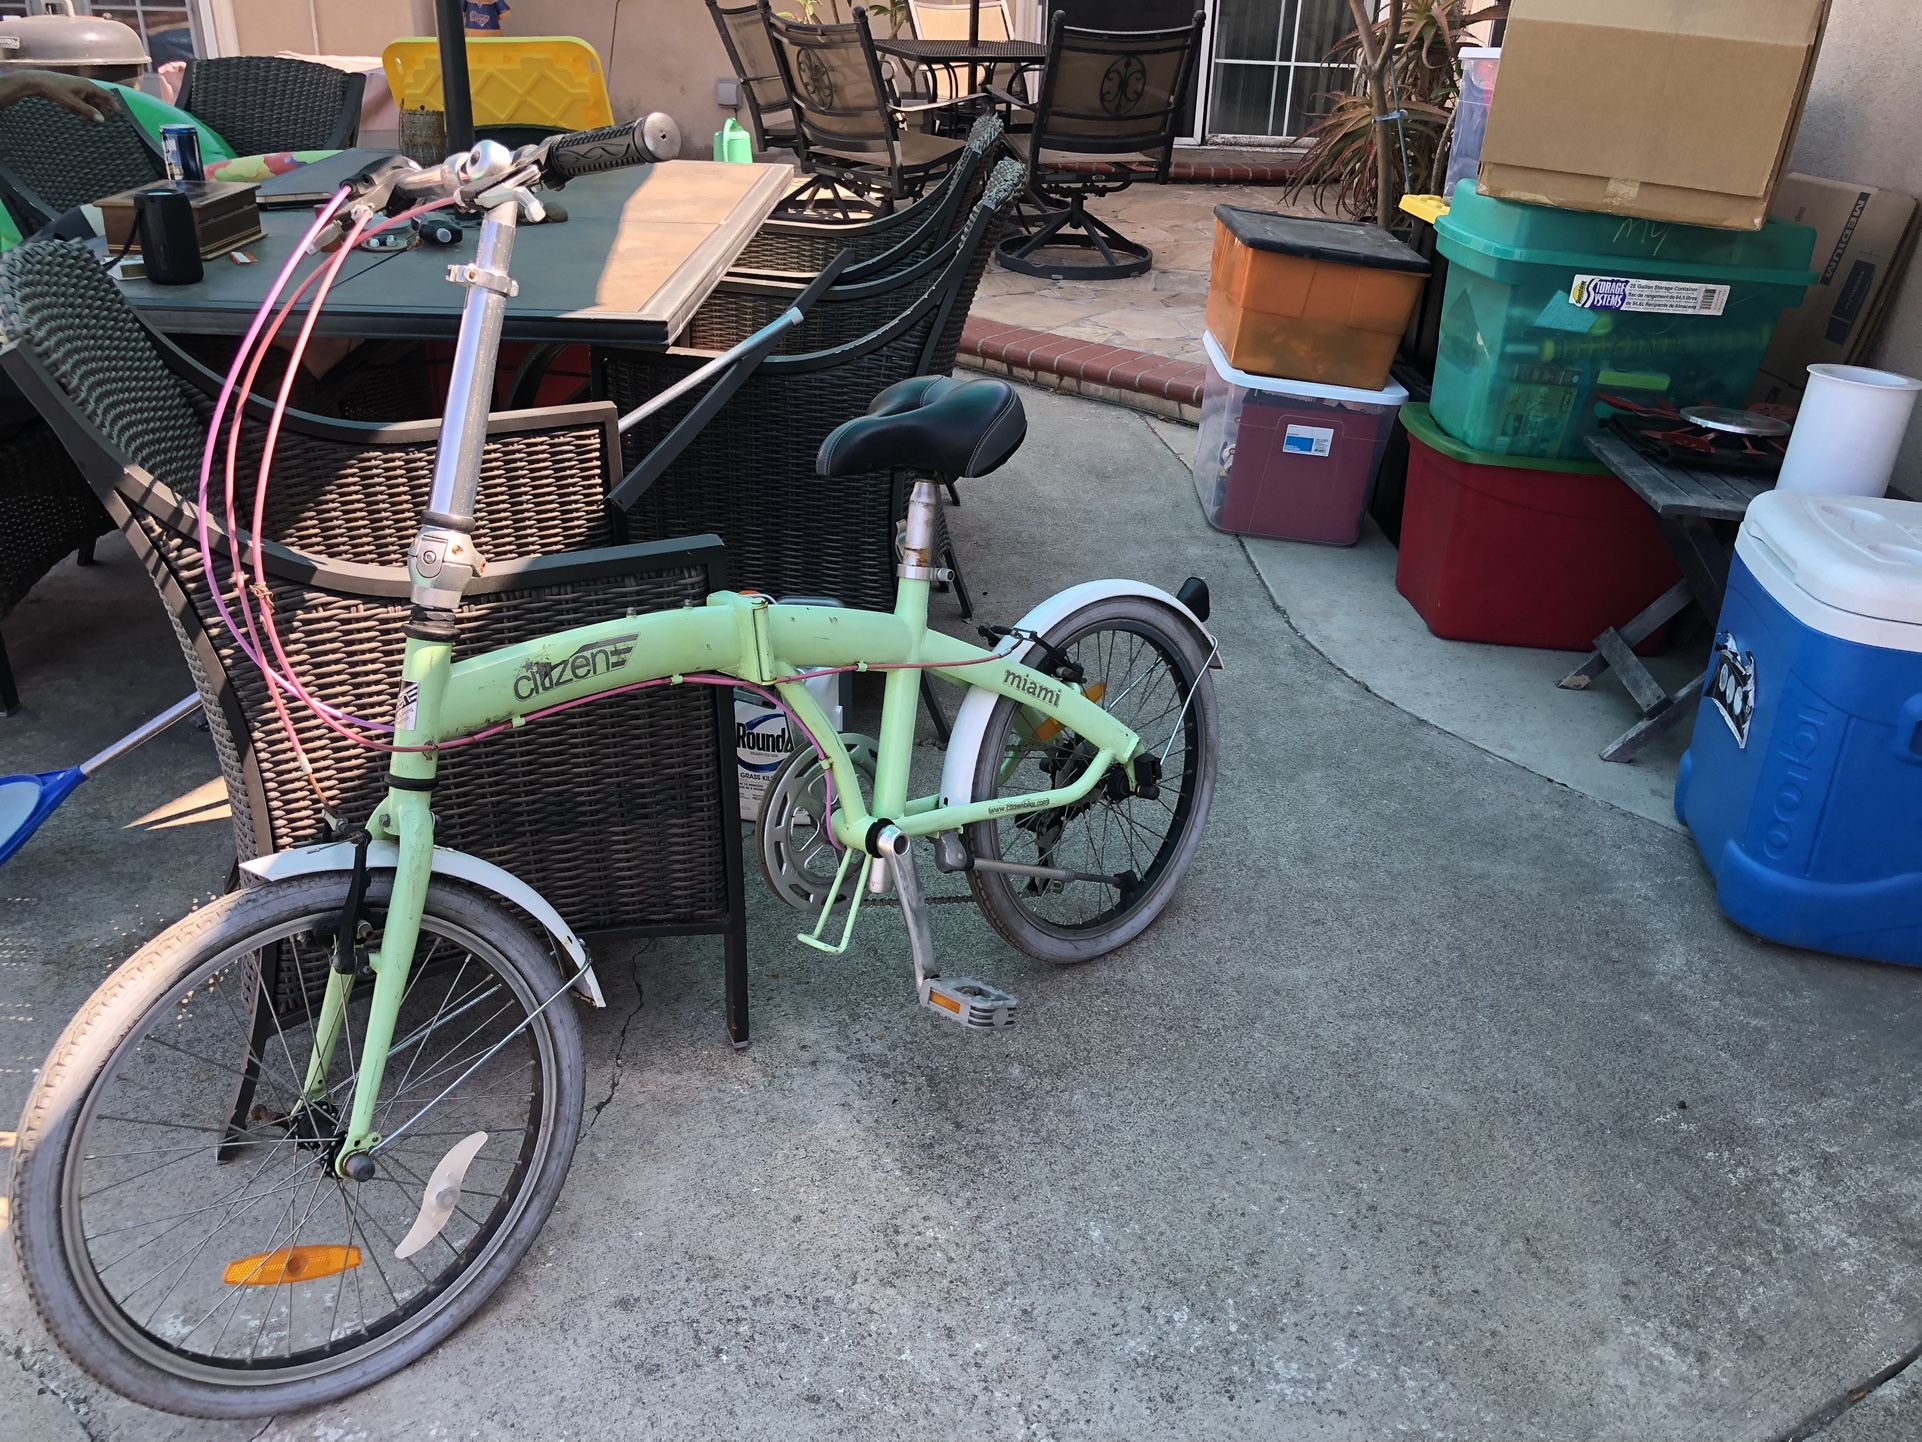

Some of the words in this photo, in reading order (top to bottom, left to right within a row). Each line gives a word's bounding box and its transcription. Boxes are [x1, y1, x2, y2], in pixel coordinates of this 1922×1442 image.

[1824, 199, 1865, 279] MEDIUM
[1586, 278, 1627, 295] STORAGE
[1654, 284, 1673, 292] Storage
[1004, 669, 1061, 708] miami
[740, 772, 761, 781] GRASS
[1763, 703, 1828, 860] igloo
